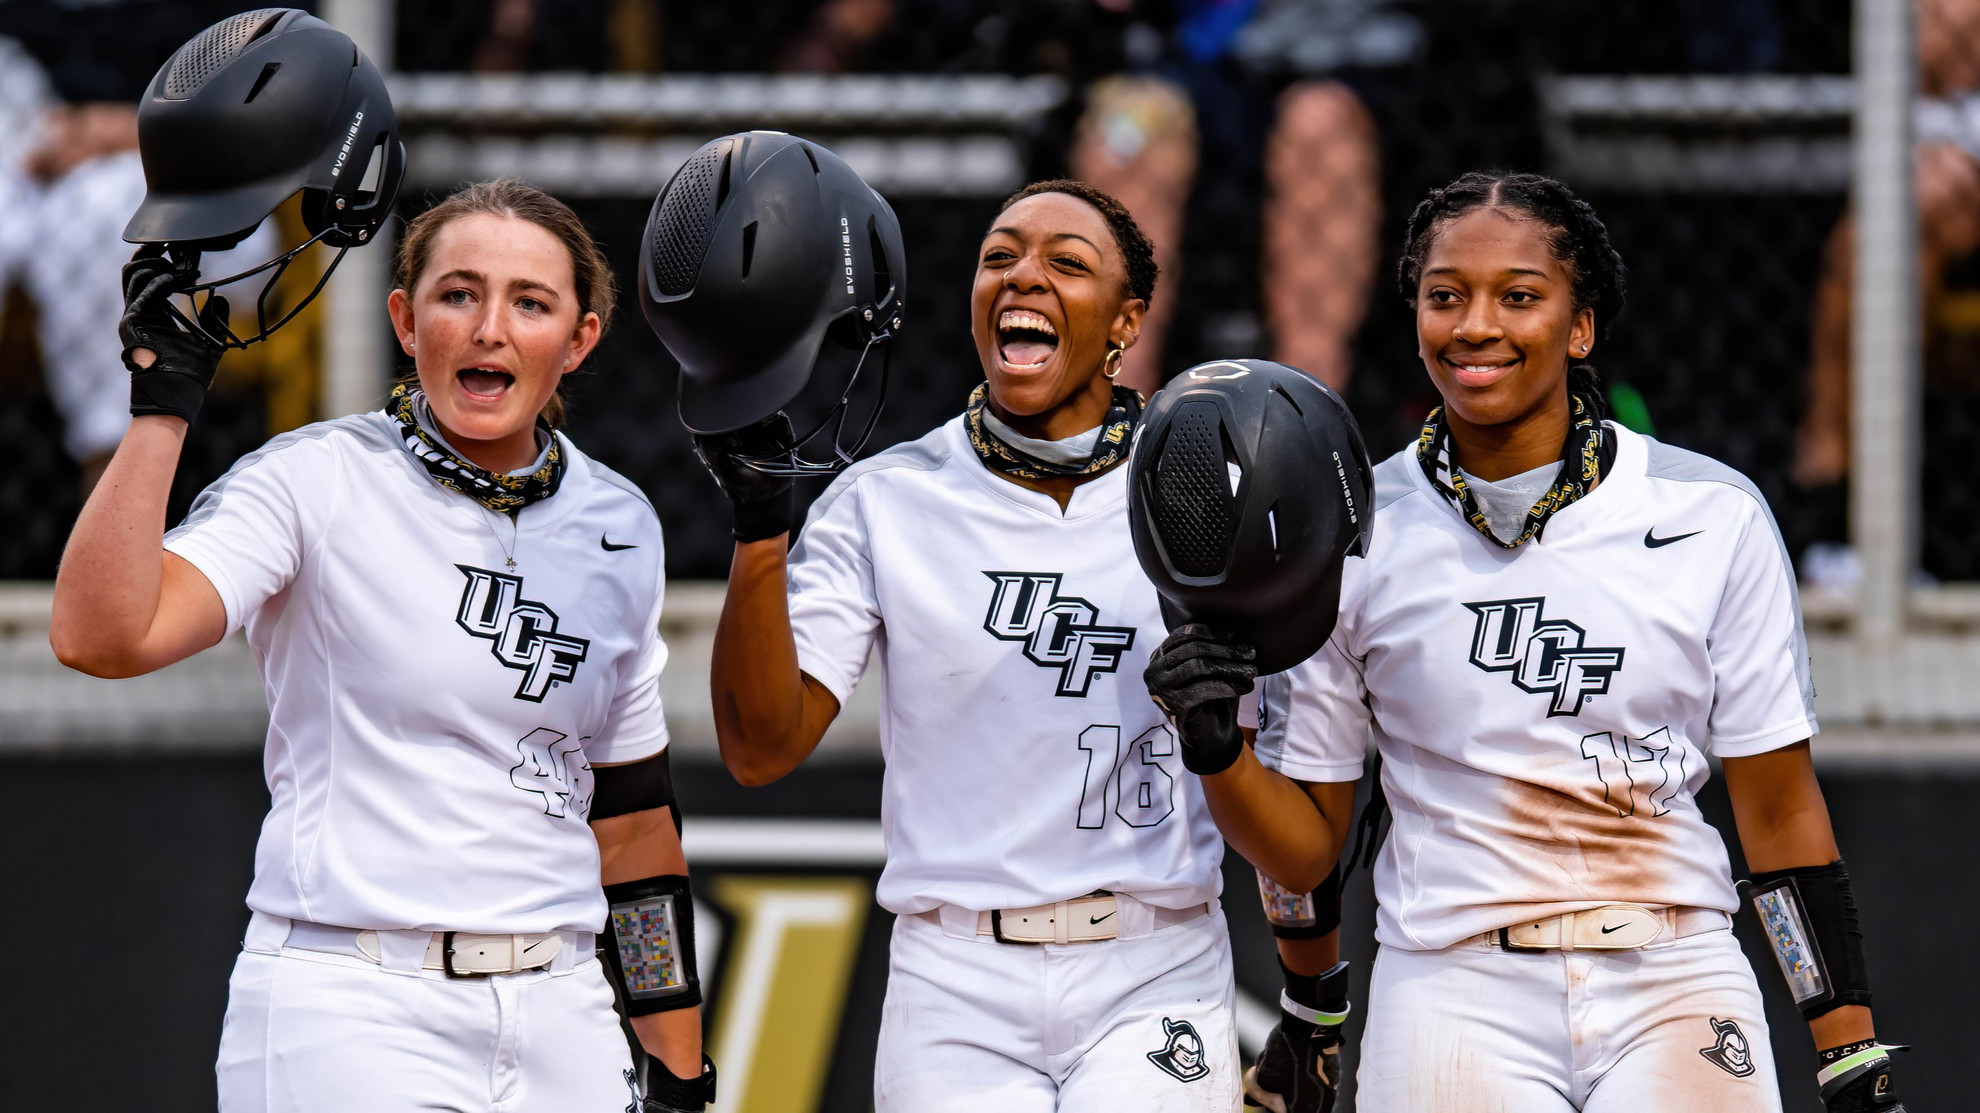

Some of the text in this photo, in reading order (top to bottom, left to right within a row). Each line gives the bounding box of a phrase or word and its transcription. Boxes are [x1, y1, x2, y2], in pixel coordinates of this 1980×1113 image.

[331, 111, 364, 177] EVOSHIELD
[840, 217, 855, 295] EVOSHIELD
[1332, 451, 1358, 524] EVOSHIELD
[453, 563, 591, 704] UCF
[980, 570, 1138, 698] UCF
[1460, 596, 1626, 719] UCF
[1076, 723, 1175, 829] 16
[1580, 725, 1686, 818] 17
